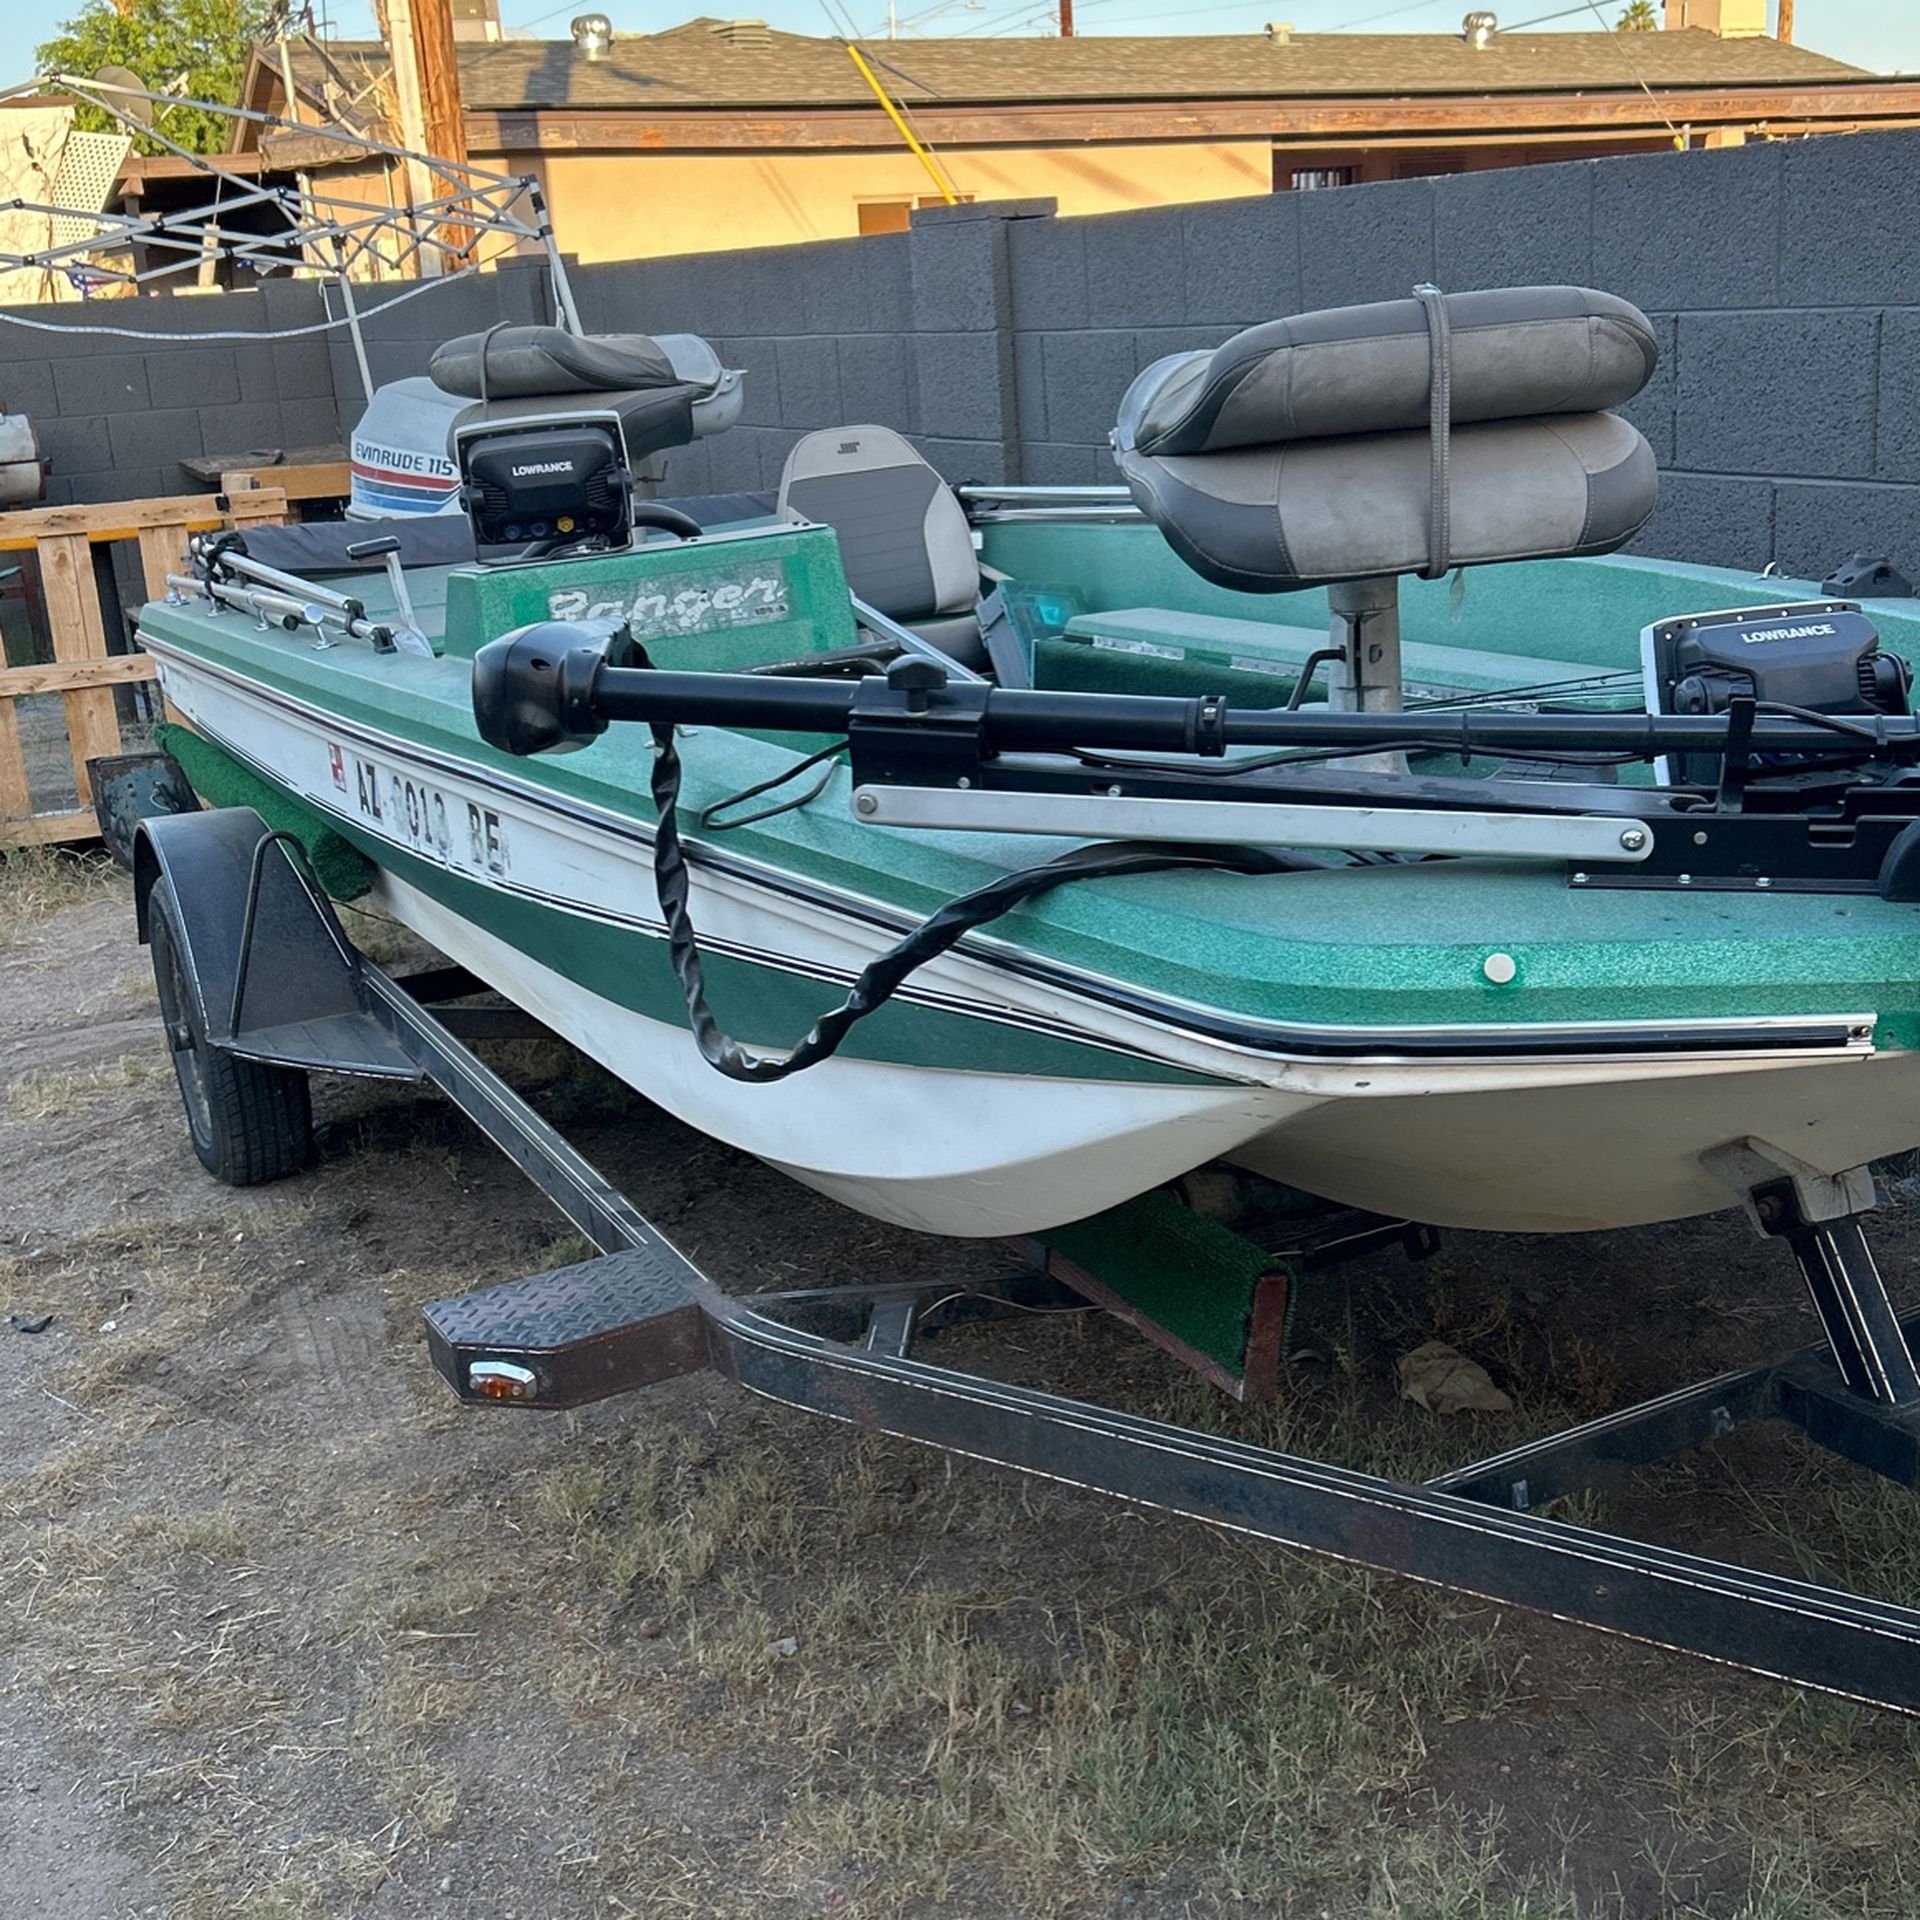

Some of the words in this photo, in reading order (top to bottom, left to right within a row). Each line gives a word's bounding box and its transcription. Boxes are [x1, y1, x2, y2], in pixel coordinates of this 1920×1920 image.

[356, 443, 424, 471] EVINRUDE
[429, 460, 453, 476] 115
[511, 460, 574, 477] LOWRANCE
[1742, 624, 1836, 643] LOWRANCE
[356, 761, 382, 819] AZ
